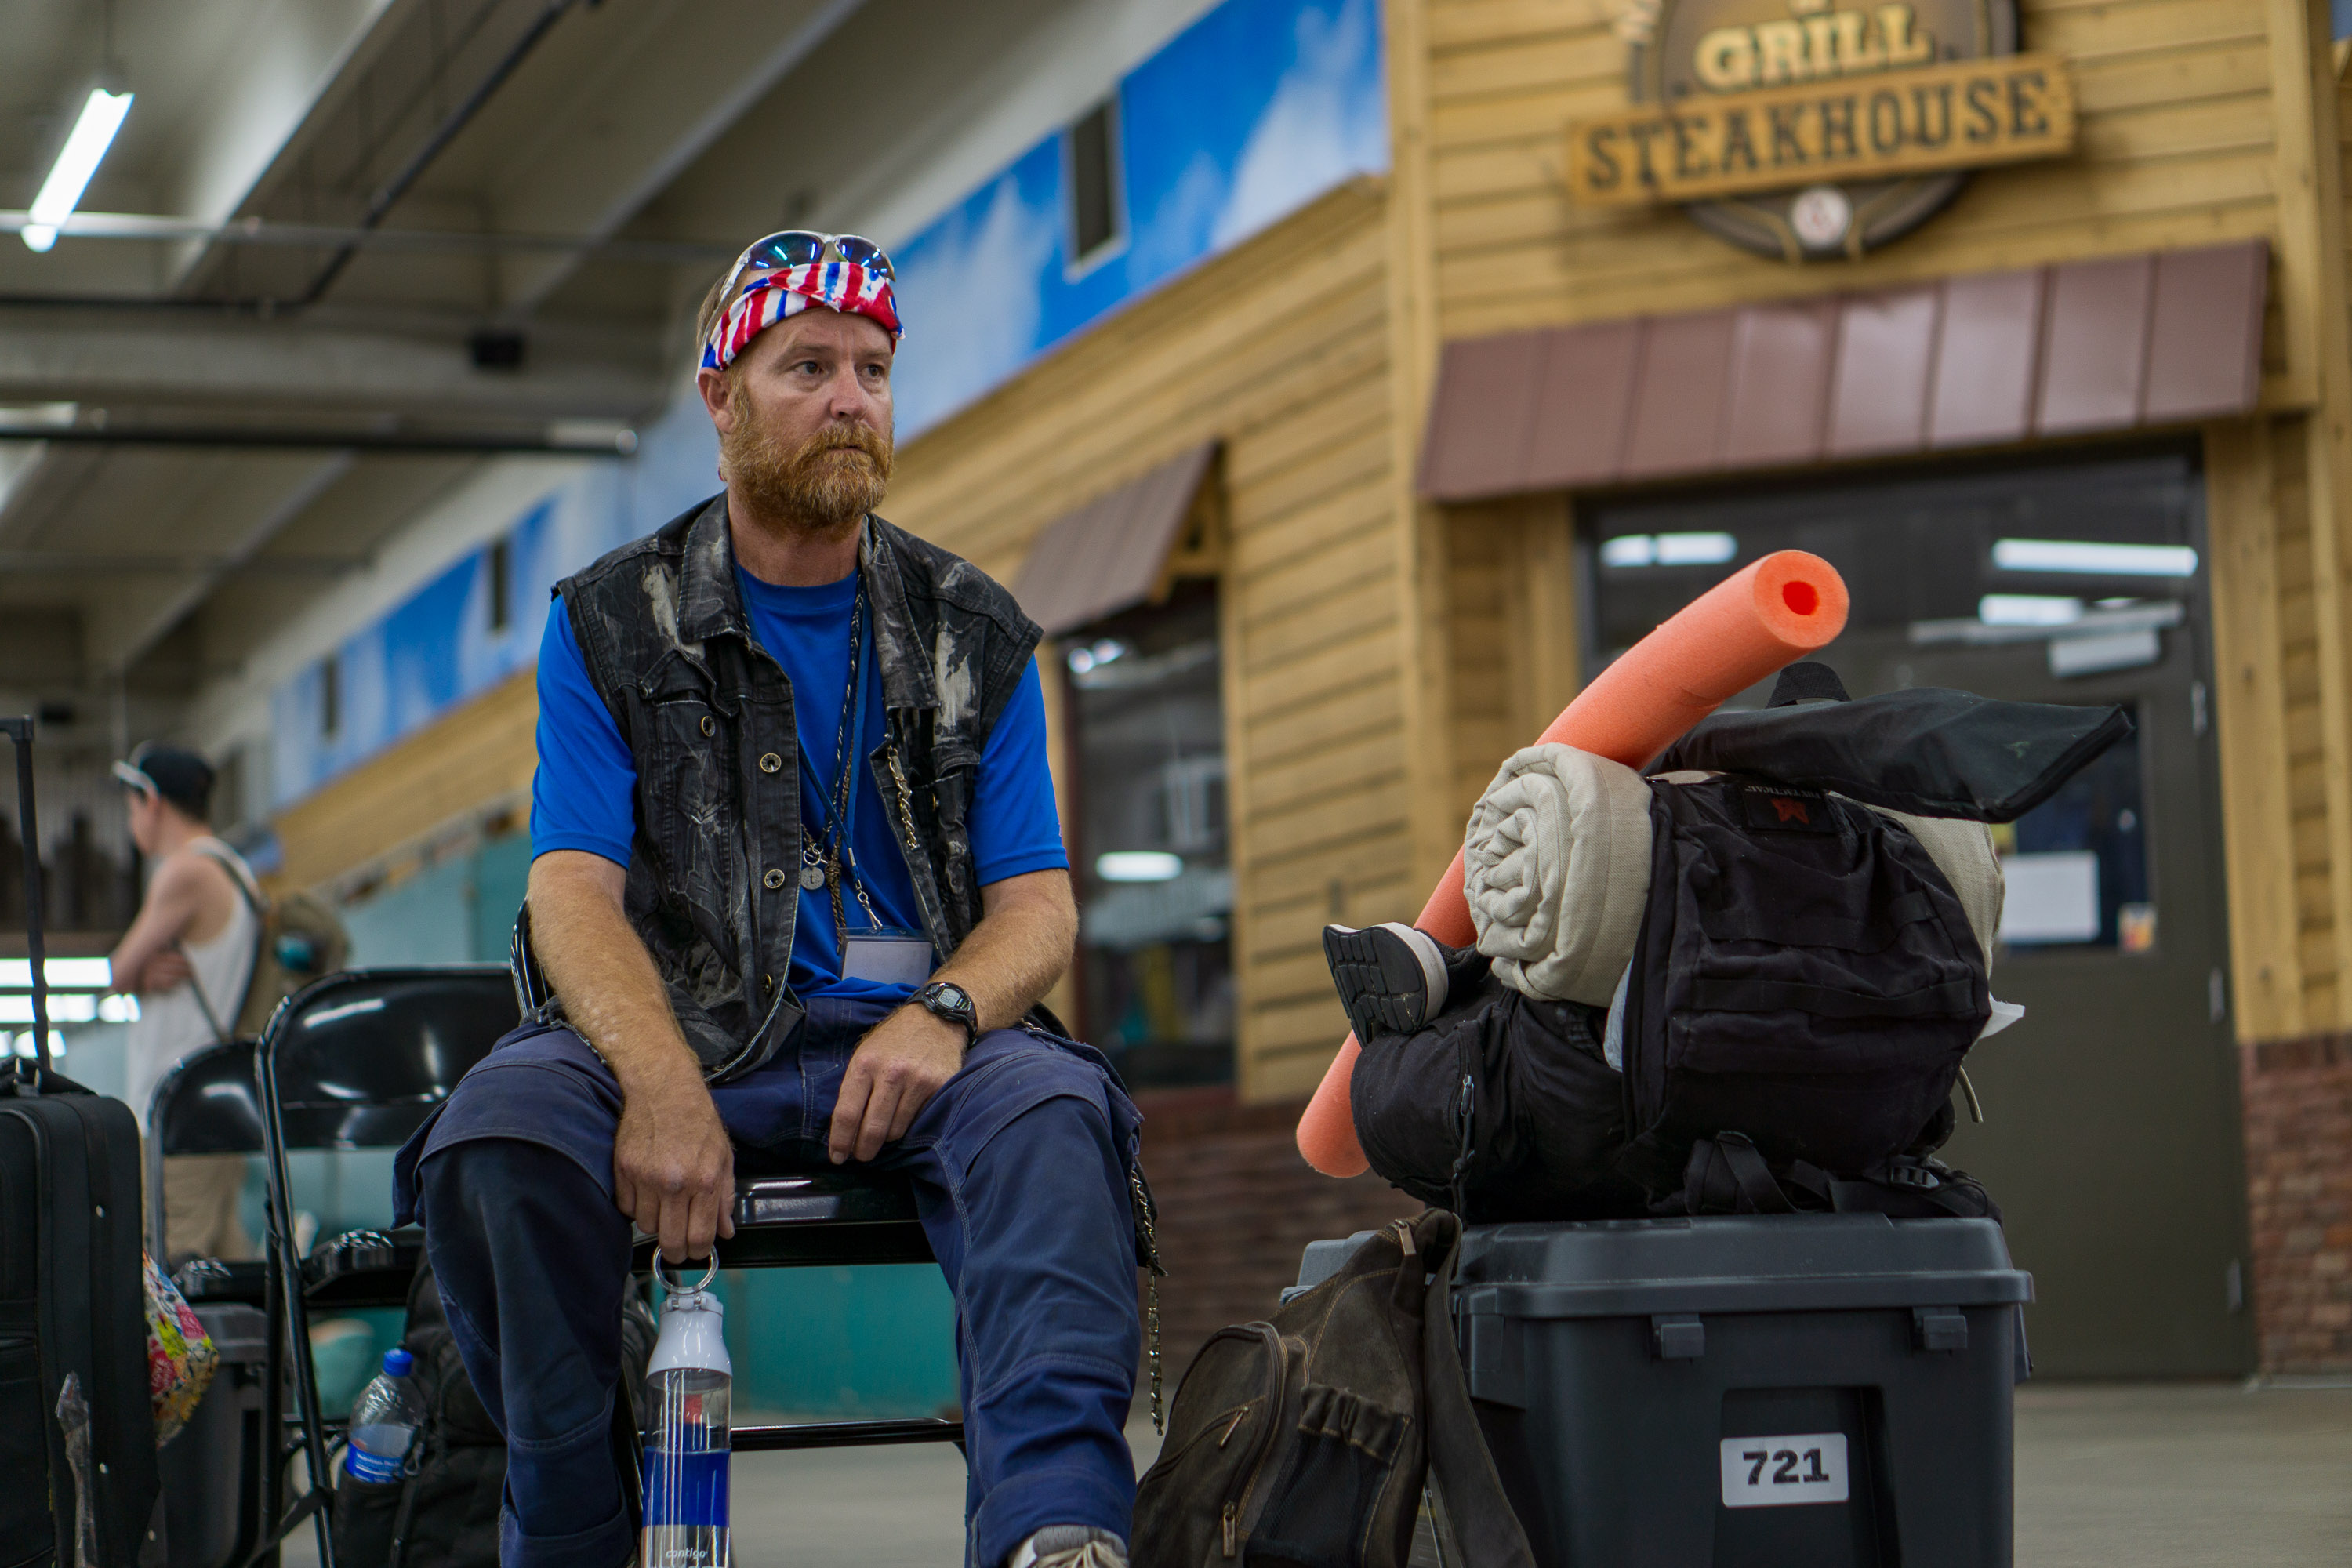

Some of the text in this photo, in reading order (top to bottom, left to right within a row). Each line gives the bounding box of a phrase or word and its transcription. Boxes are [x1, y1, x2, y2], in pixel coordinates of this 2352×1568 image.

[1695, 5, 1932, 89] GRILL
[1585, 70, 2049, 190] STEAKHOUSE
[1742, 1447, 1829, 1486] 721
[666, 1548, 706, 1559] contigo
